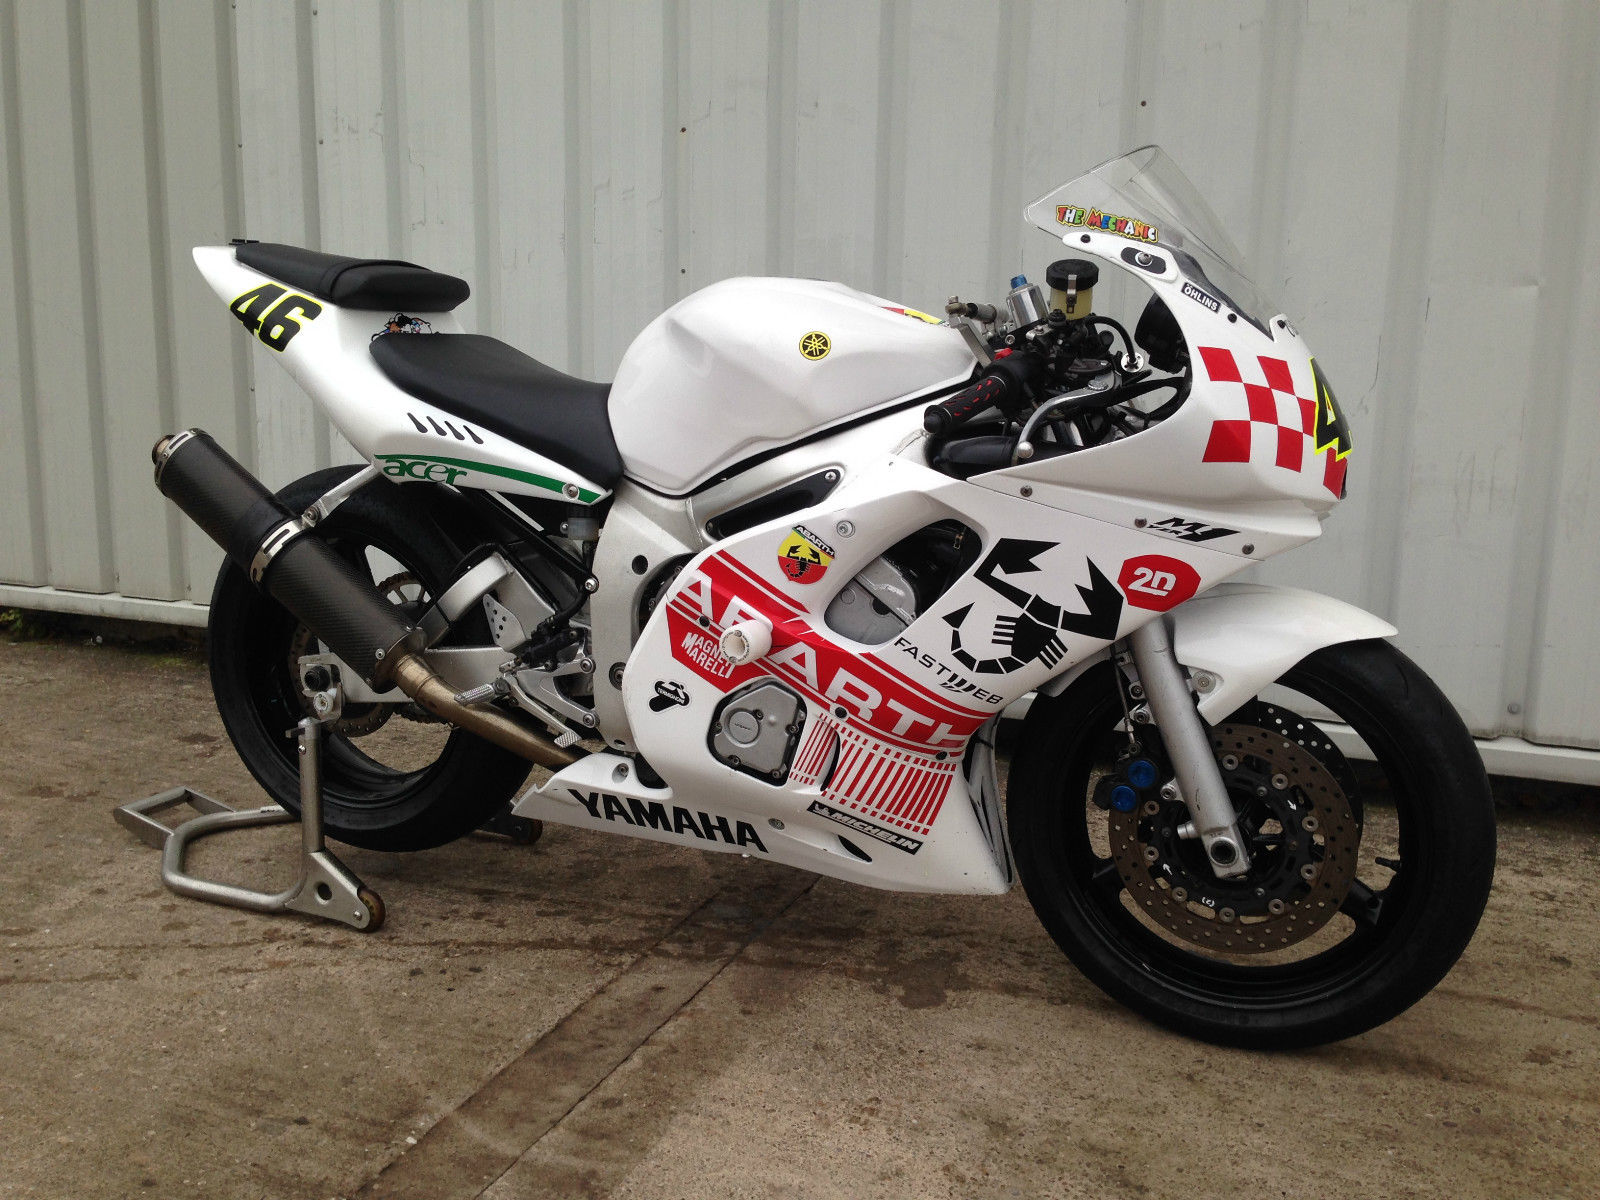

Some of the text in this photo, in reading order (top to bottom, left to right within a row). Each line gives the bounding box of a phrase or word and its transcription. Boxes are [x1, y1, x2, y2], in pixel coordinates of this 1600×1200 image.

[1057, 205, 1158, 242] THE MECHANIC
[1184, 283, 1218, 311] ÖHLINS
[229, 282, 324, 353] 46
[383, 459, 468, 485] acer
[796, 526, 835, 556] ABARTH
[567, 789, 769, 854] YAMAHA
[830, 811, 920, 850] MICHELIN
